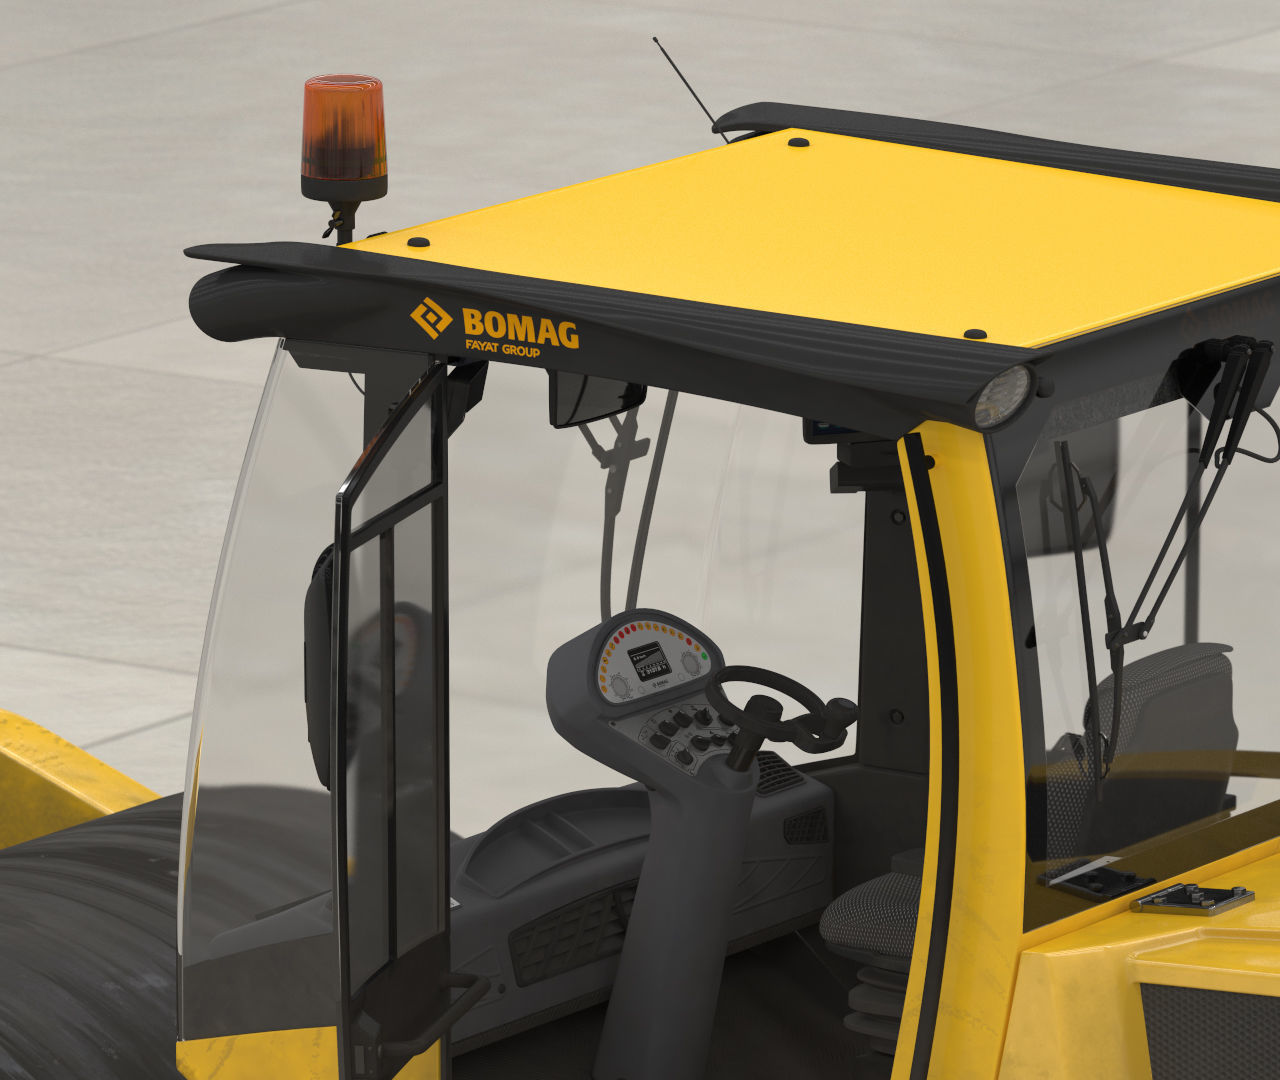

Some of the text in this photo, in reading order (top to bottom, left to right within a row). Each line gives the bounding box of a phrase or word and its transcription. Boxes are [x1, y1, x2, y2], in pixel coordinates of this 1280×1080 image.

[462, 307, 580, 349] BOMAG
[465, 339, 541, 358] FAYAT GROUP
